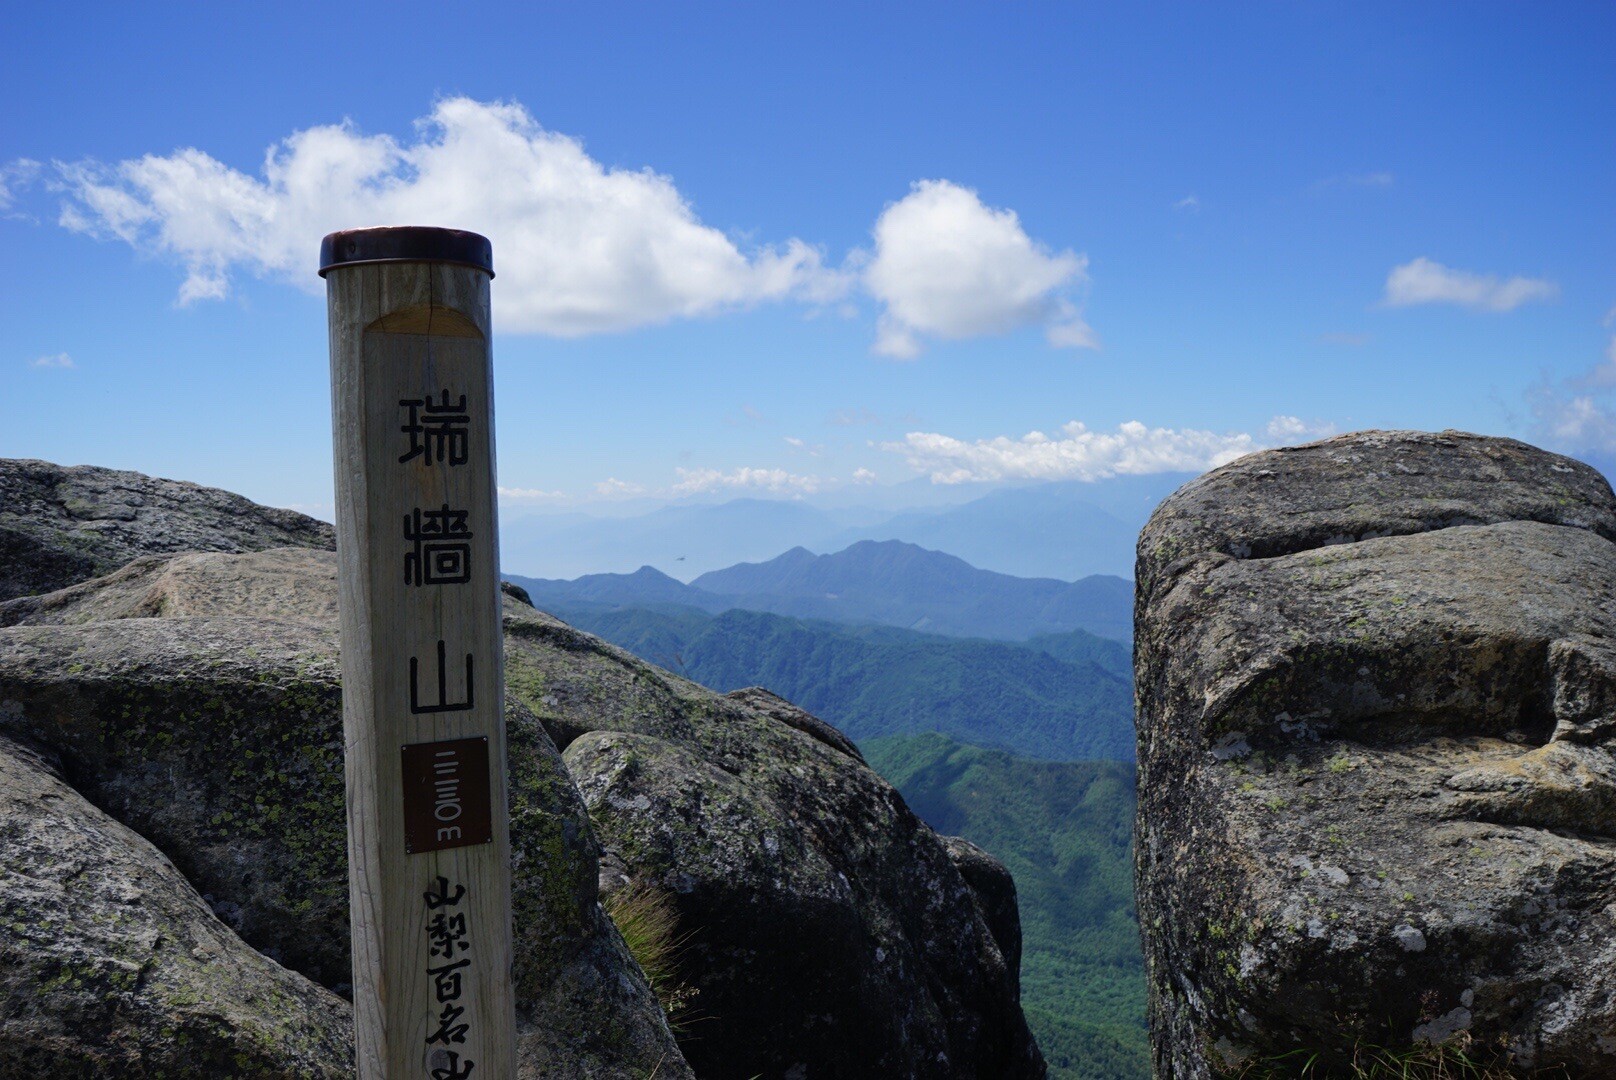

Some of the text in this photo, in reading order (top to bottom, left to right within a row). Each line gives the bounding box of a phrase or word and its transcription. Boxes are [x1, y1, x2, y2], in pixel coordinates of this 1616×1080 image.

[398, 388, 474, 714] 瑞牆山
[423, 875, 475, 1080] 山梨百名山
